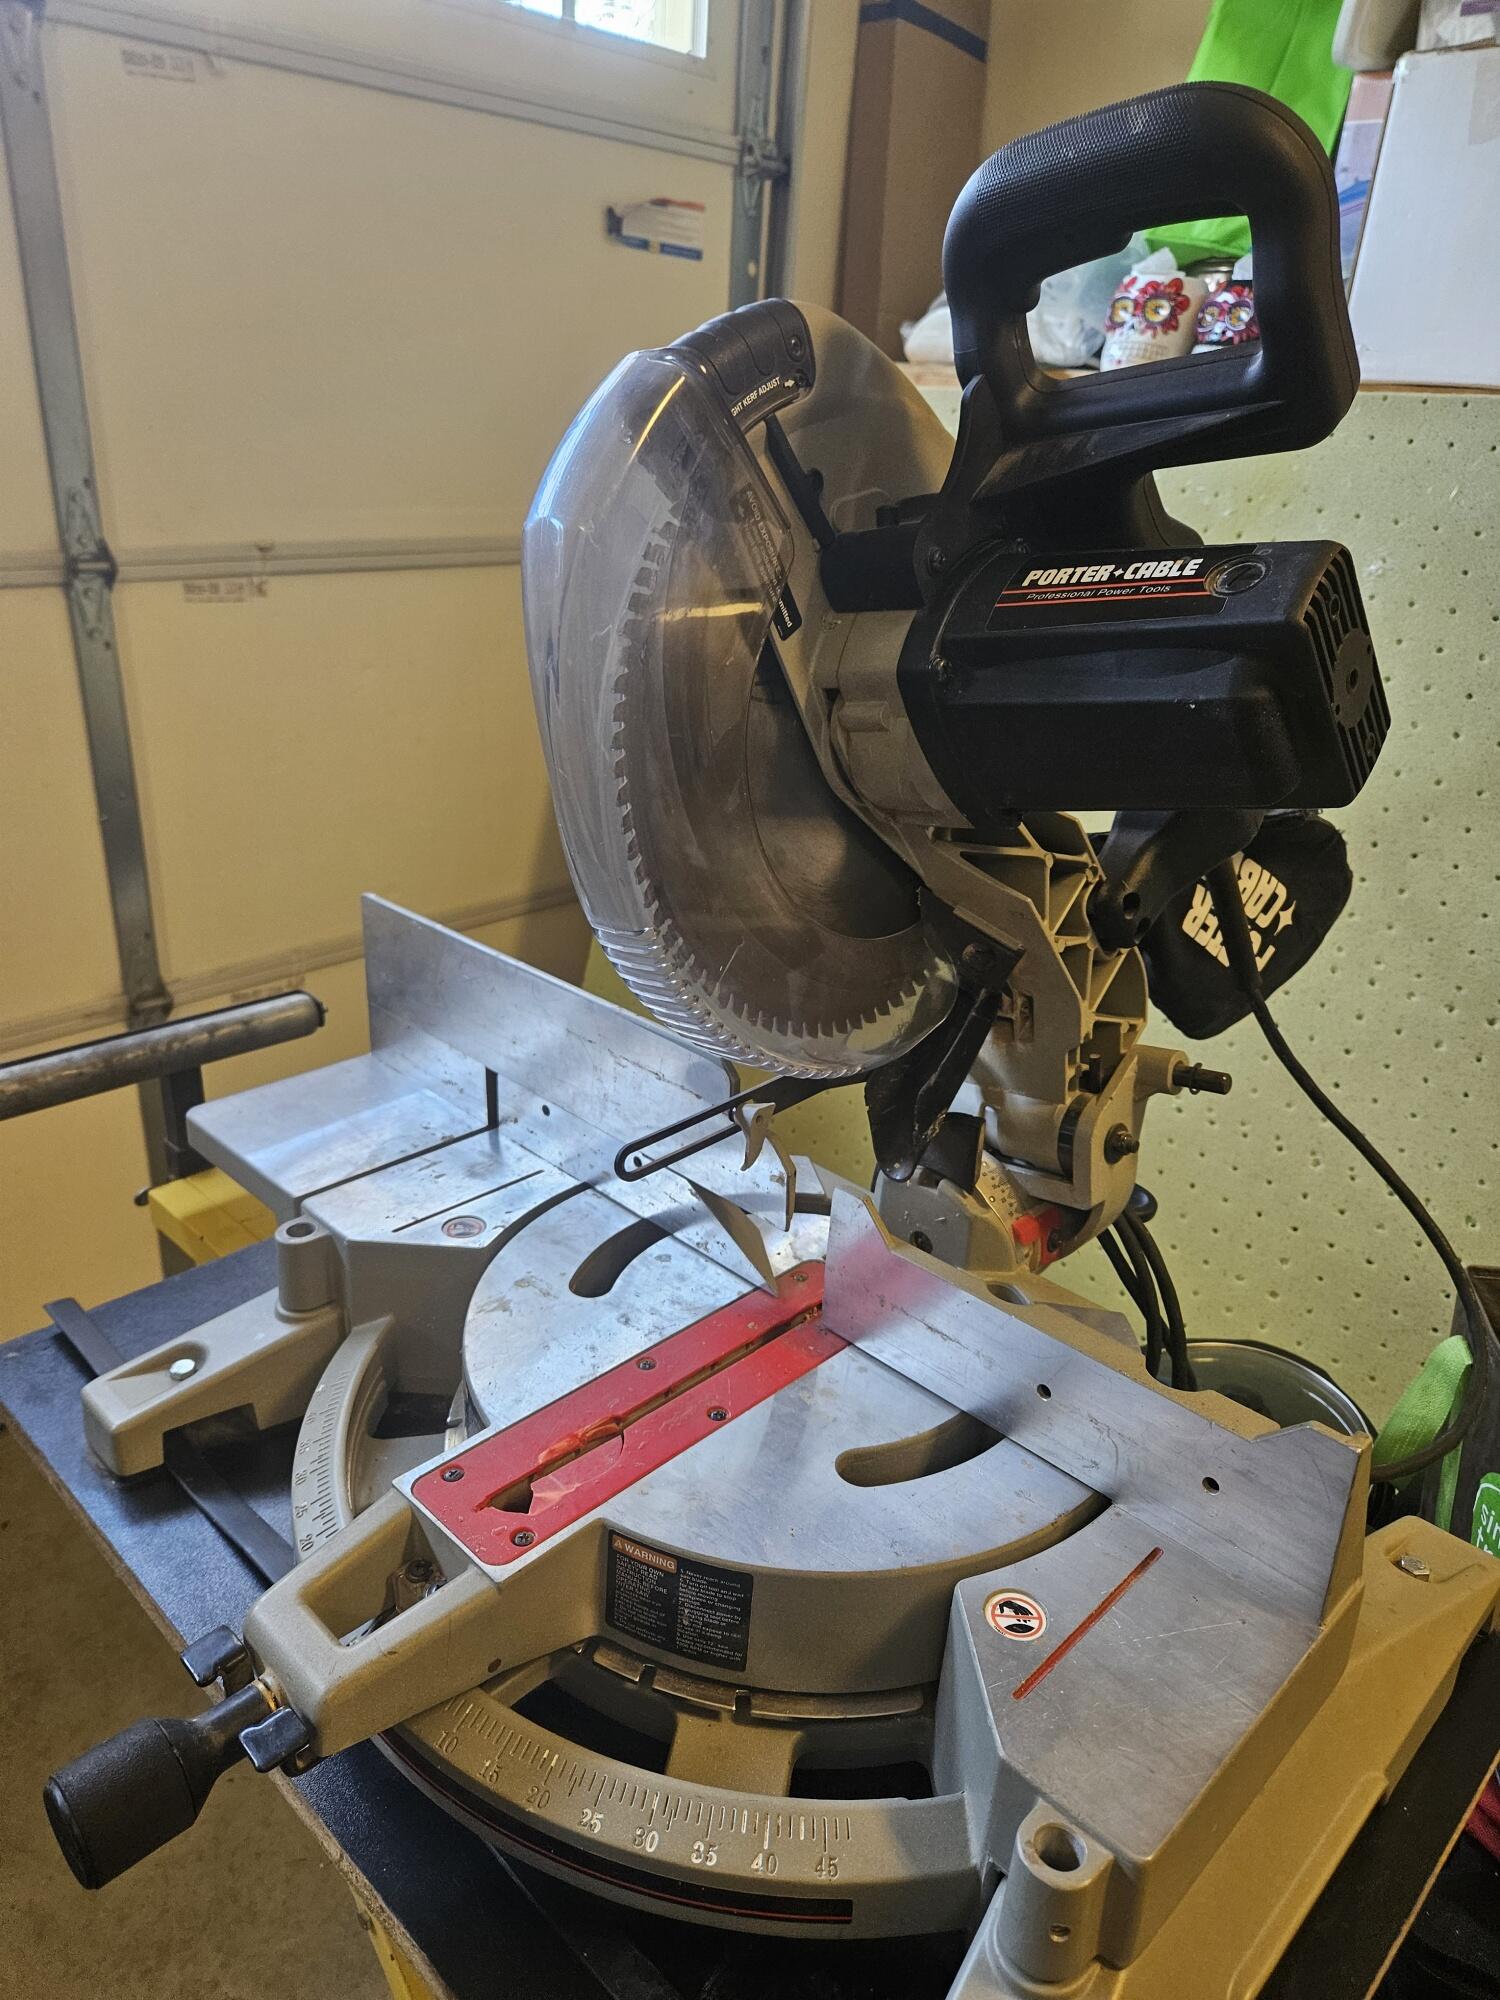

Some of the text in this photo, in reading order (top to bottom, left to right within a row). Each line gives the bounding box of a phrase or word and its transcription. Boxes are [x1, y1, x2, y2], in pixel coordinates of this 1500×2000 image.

[730, 377, 781, 417] GHT KERF ADJUST
[746, 490, 762, 522] AVOID
[1026, 584, 1172, 602] Professional Power Tools
[777, 597, 794, 629] mitted
[1230, 850, 1288, 929] CAB
[294, 1500, 309, 1519] 25
[299, 1533, 315, 1552] 20
[624, 1543, 675, 1570] WARNING
[640, 1569, 657, 1580] READ
[648, 1567, 665, 1578] OWN
[433, 1730, 840, 1880] 10 15 20 25 30 35 40 45
